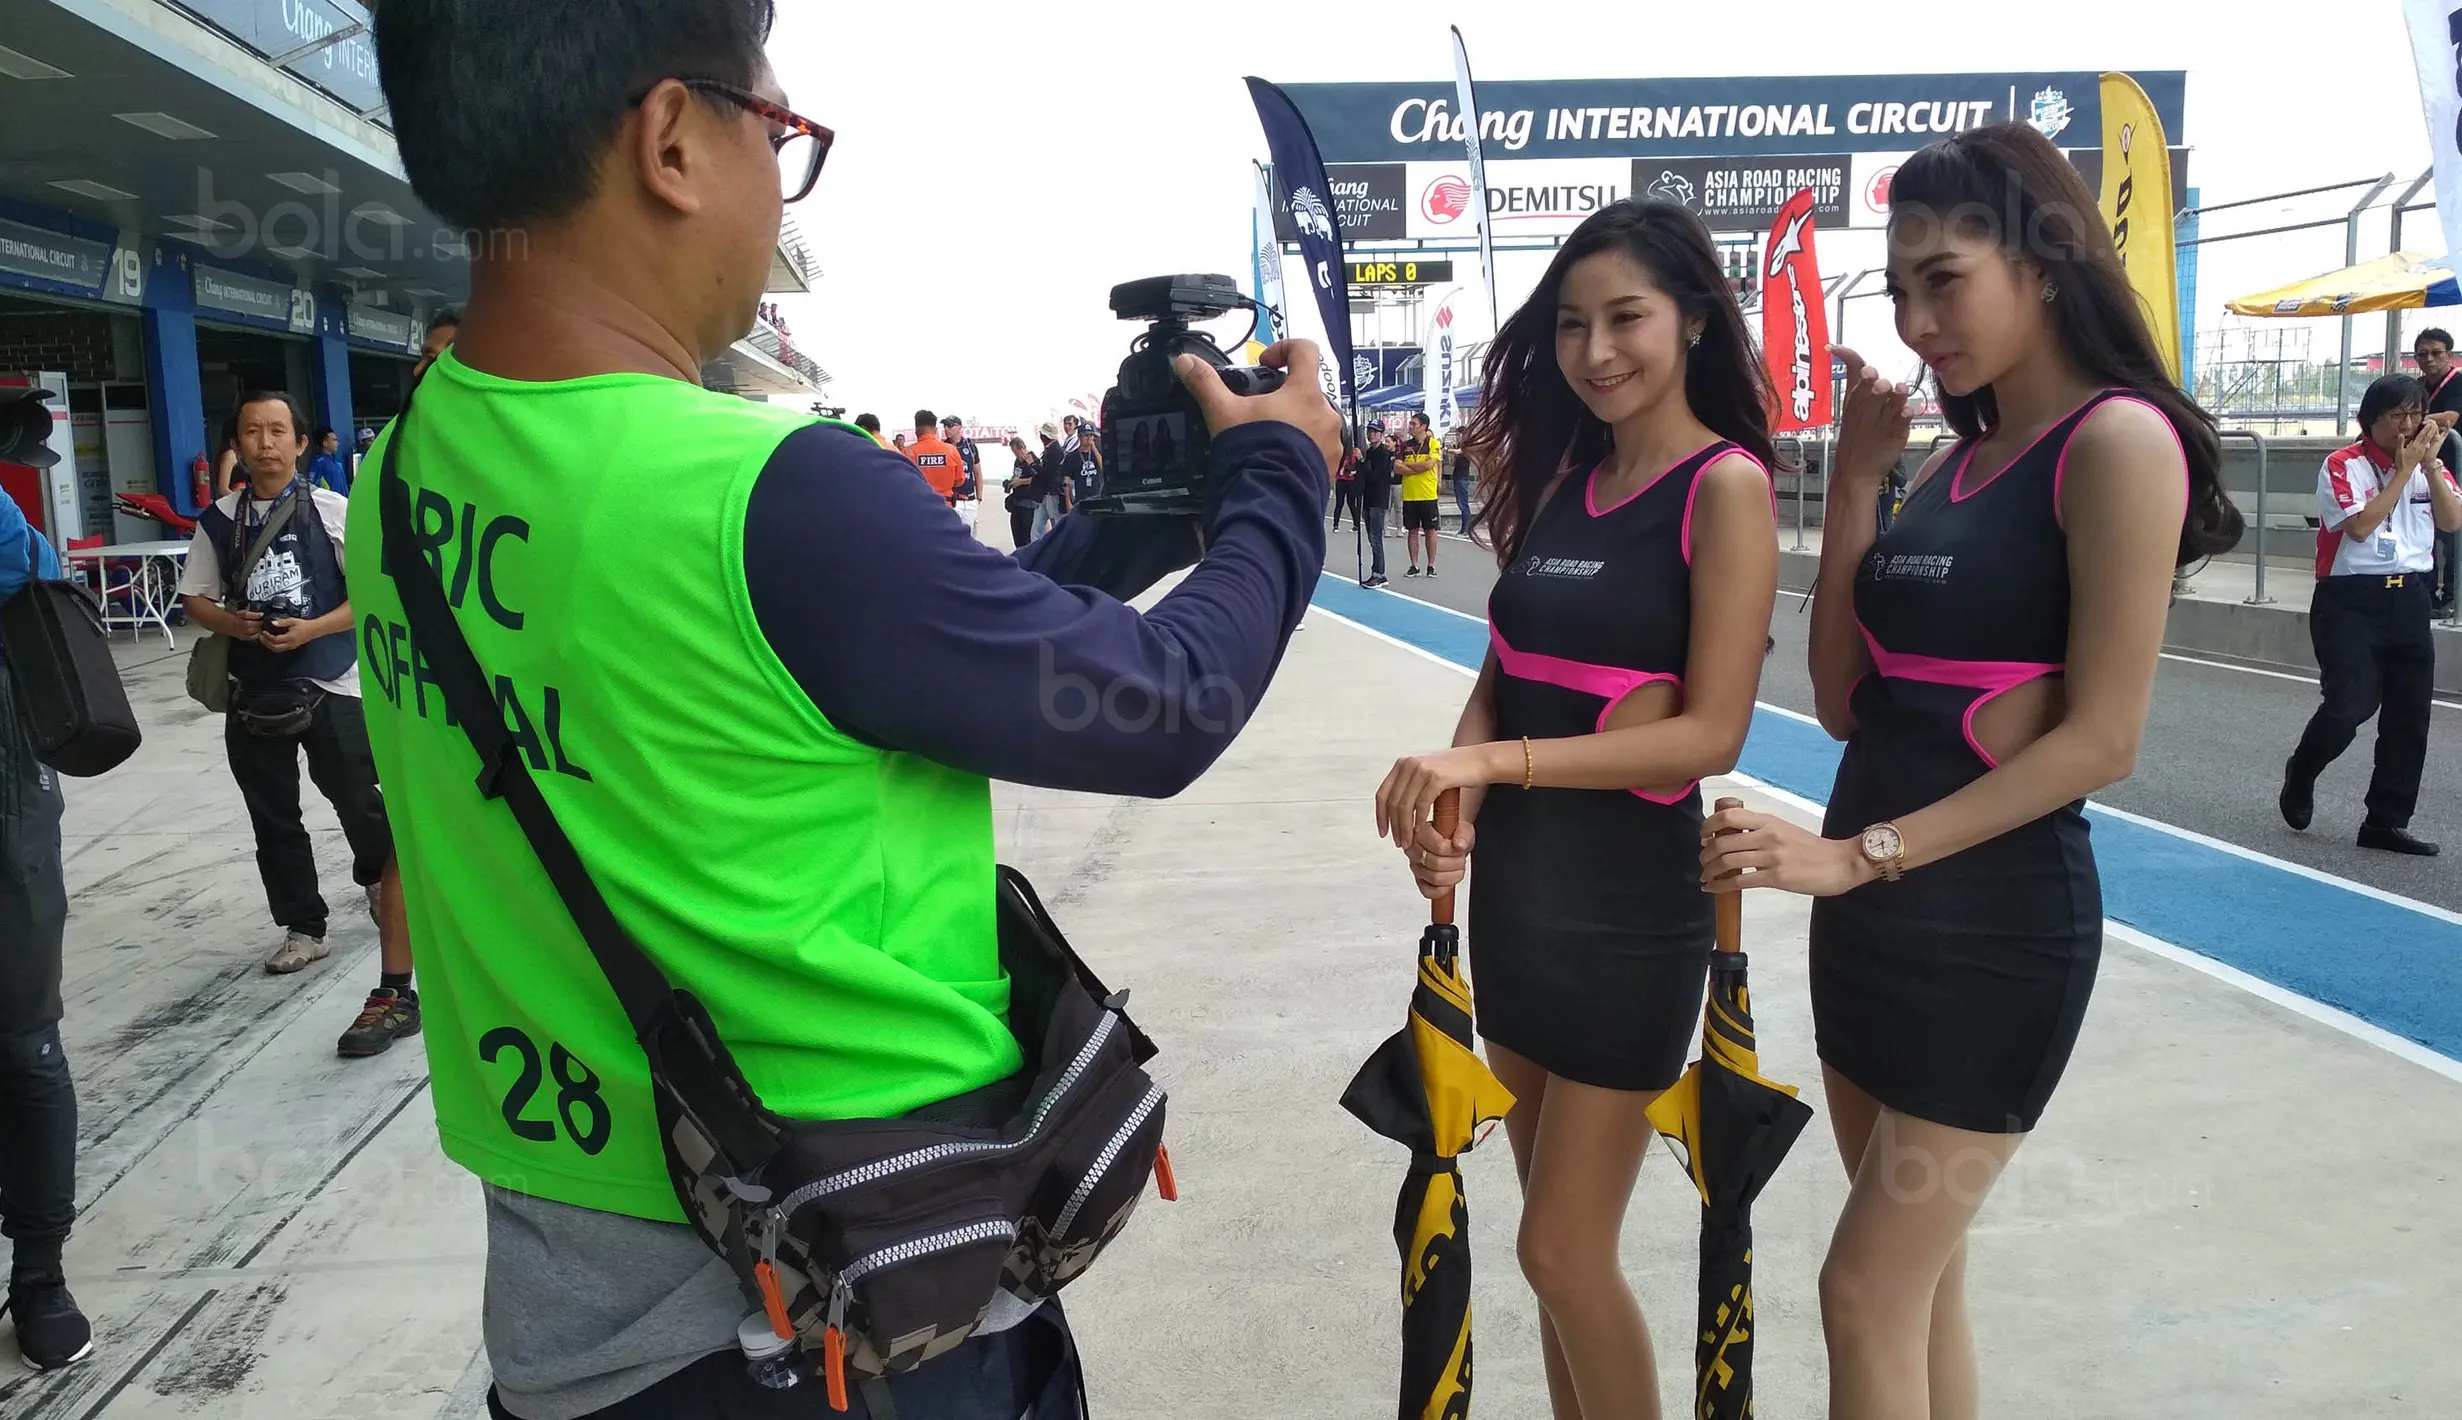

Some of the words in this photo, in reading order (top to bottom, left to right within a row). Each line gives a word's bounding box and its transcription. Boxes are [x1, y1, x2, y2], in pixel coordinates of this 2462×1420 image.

[1546, 103, 1836, 141] INTERNATIONAL
[1847, 101, 1993, 135] CIRCUIT
[1327, 177, 1369, 199] hang
[1704, 170, 1738, 189] ASIA
[1742, 169, 1782, 188] ROAD
[1786, 167, 1842, 187] RACING
[1487, 185, 1616, 212] DEMITSU
[1704, 186, 1840, 207] CHAMPIONHIP
[49, 248, 75, 269] CIRCUIT
[111, 247, 142, 297] 19
[1355, 263, 1397, 282] LAPS
[1405, 262, 1417, 281] 0
[291, 288, 315, 328] 20
[411, 319, 424, 350] 21
[919, 455, 945, 465] FIRE
[1538, 564, 1600, 577] CHAMPIONSHIP
[1885, 564, 1949, 579] CHAMPIONSHIP
[1922, 555, 1954, 568] RACING
[363, 613, 594, 783] OFFAL
[478, 1025, 612, 1156] 28
